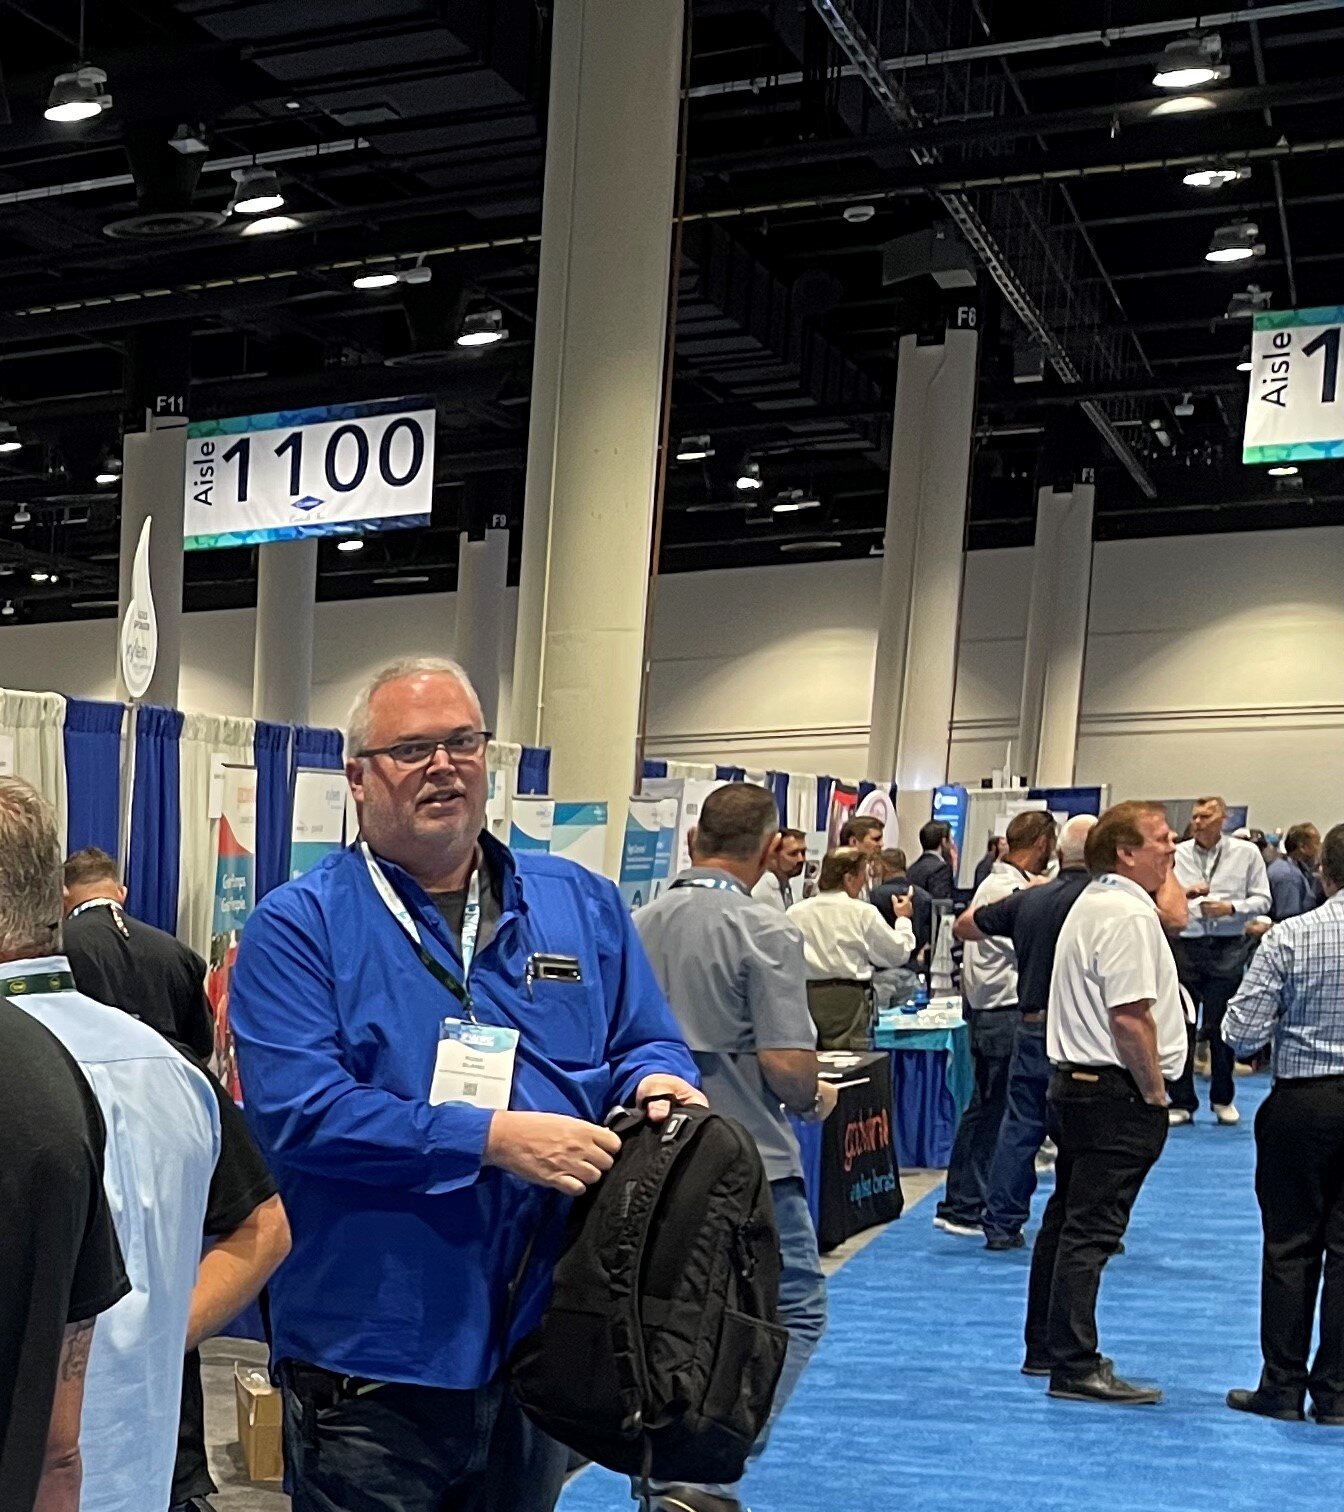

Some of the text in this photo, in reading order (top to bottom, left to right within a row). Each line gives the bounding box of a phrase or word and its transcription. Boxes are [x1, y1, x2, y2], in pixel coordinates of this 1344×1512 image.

[157, 396, 183, 412] F11
[1261, 332, 1292, 407] Aisle
[193, 417, 424, 506] Aisle 1100
